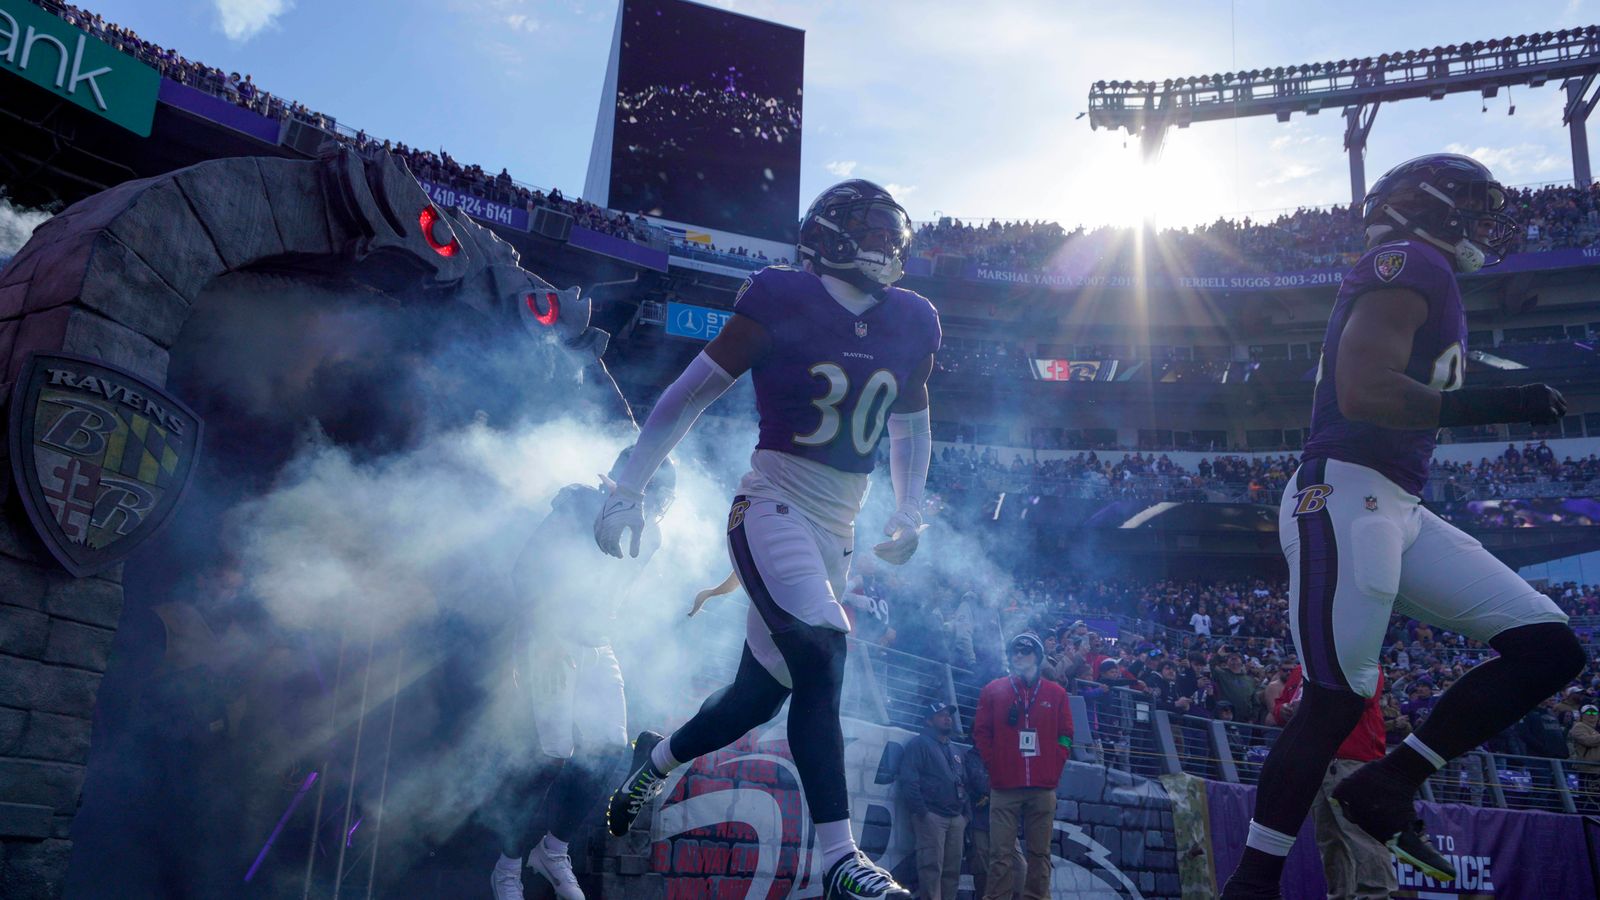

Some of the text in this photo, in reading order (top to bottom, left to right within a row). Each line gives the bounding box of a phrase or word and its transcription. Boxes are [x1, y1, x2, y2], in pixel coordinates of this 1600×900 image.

[433, 188, 512, 224] 410-324-6141
[977, 268, 1030, 284] MARSHAL
[1033, 275, 1073, 286] YANDA
[1179, 272, 1343, 289] TERRELL SUGGS 2003-2018
[841, 351, 875, 360] RAVENS
[47, 368, 185, 436] RAVENS
[791, 361, 898, 456] 30
[1292, 484, 1334, 518] B
[1436, 834, 1455, 852] TO
